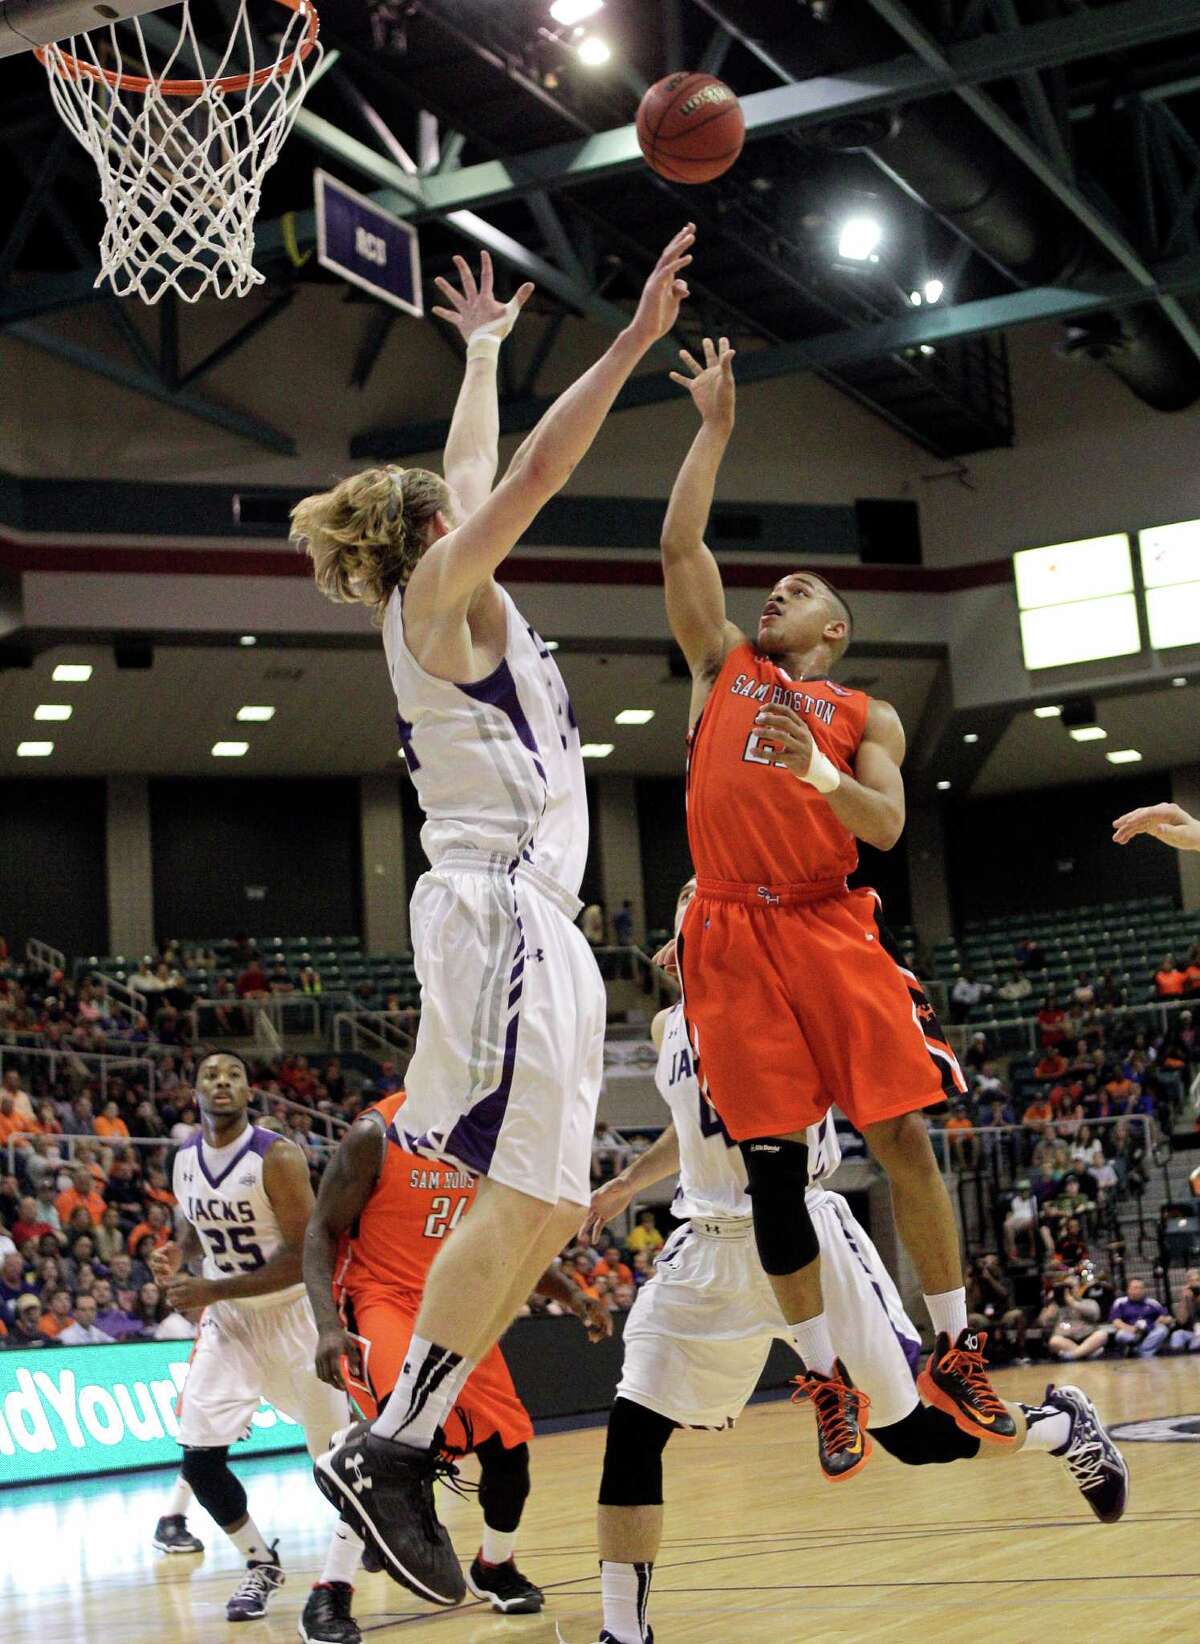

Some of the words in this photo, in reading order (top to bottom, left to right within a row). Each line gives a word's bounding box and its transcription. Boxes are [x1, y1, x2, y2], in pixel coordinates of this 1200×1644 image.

[731, 674, 770, 702] SAM
[410, 1168, 440, 1189] SAM
[188, 1197, 256, 1223] JACKS
[201, 1226, 266, 1273] 25
